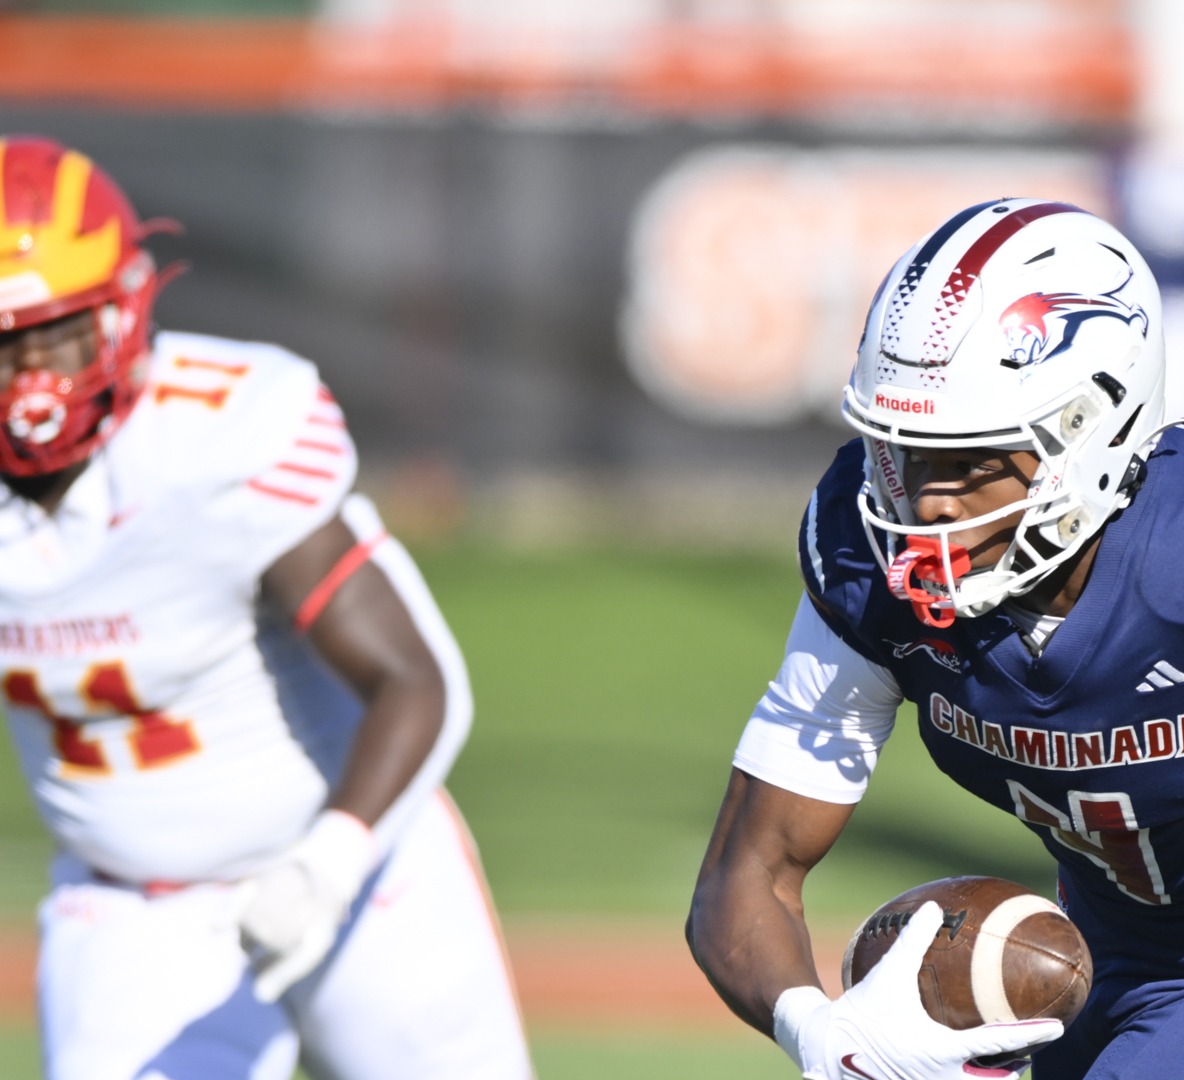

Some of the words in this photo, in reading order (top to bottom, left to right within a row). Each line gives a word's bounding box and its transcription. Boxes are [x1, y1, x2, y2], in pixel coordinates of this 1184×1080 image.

[875, 439, 906, 500] Riddell
[2, 659, 203, 779] 11
[1006, 779, 1172, 905] 4
